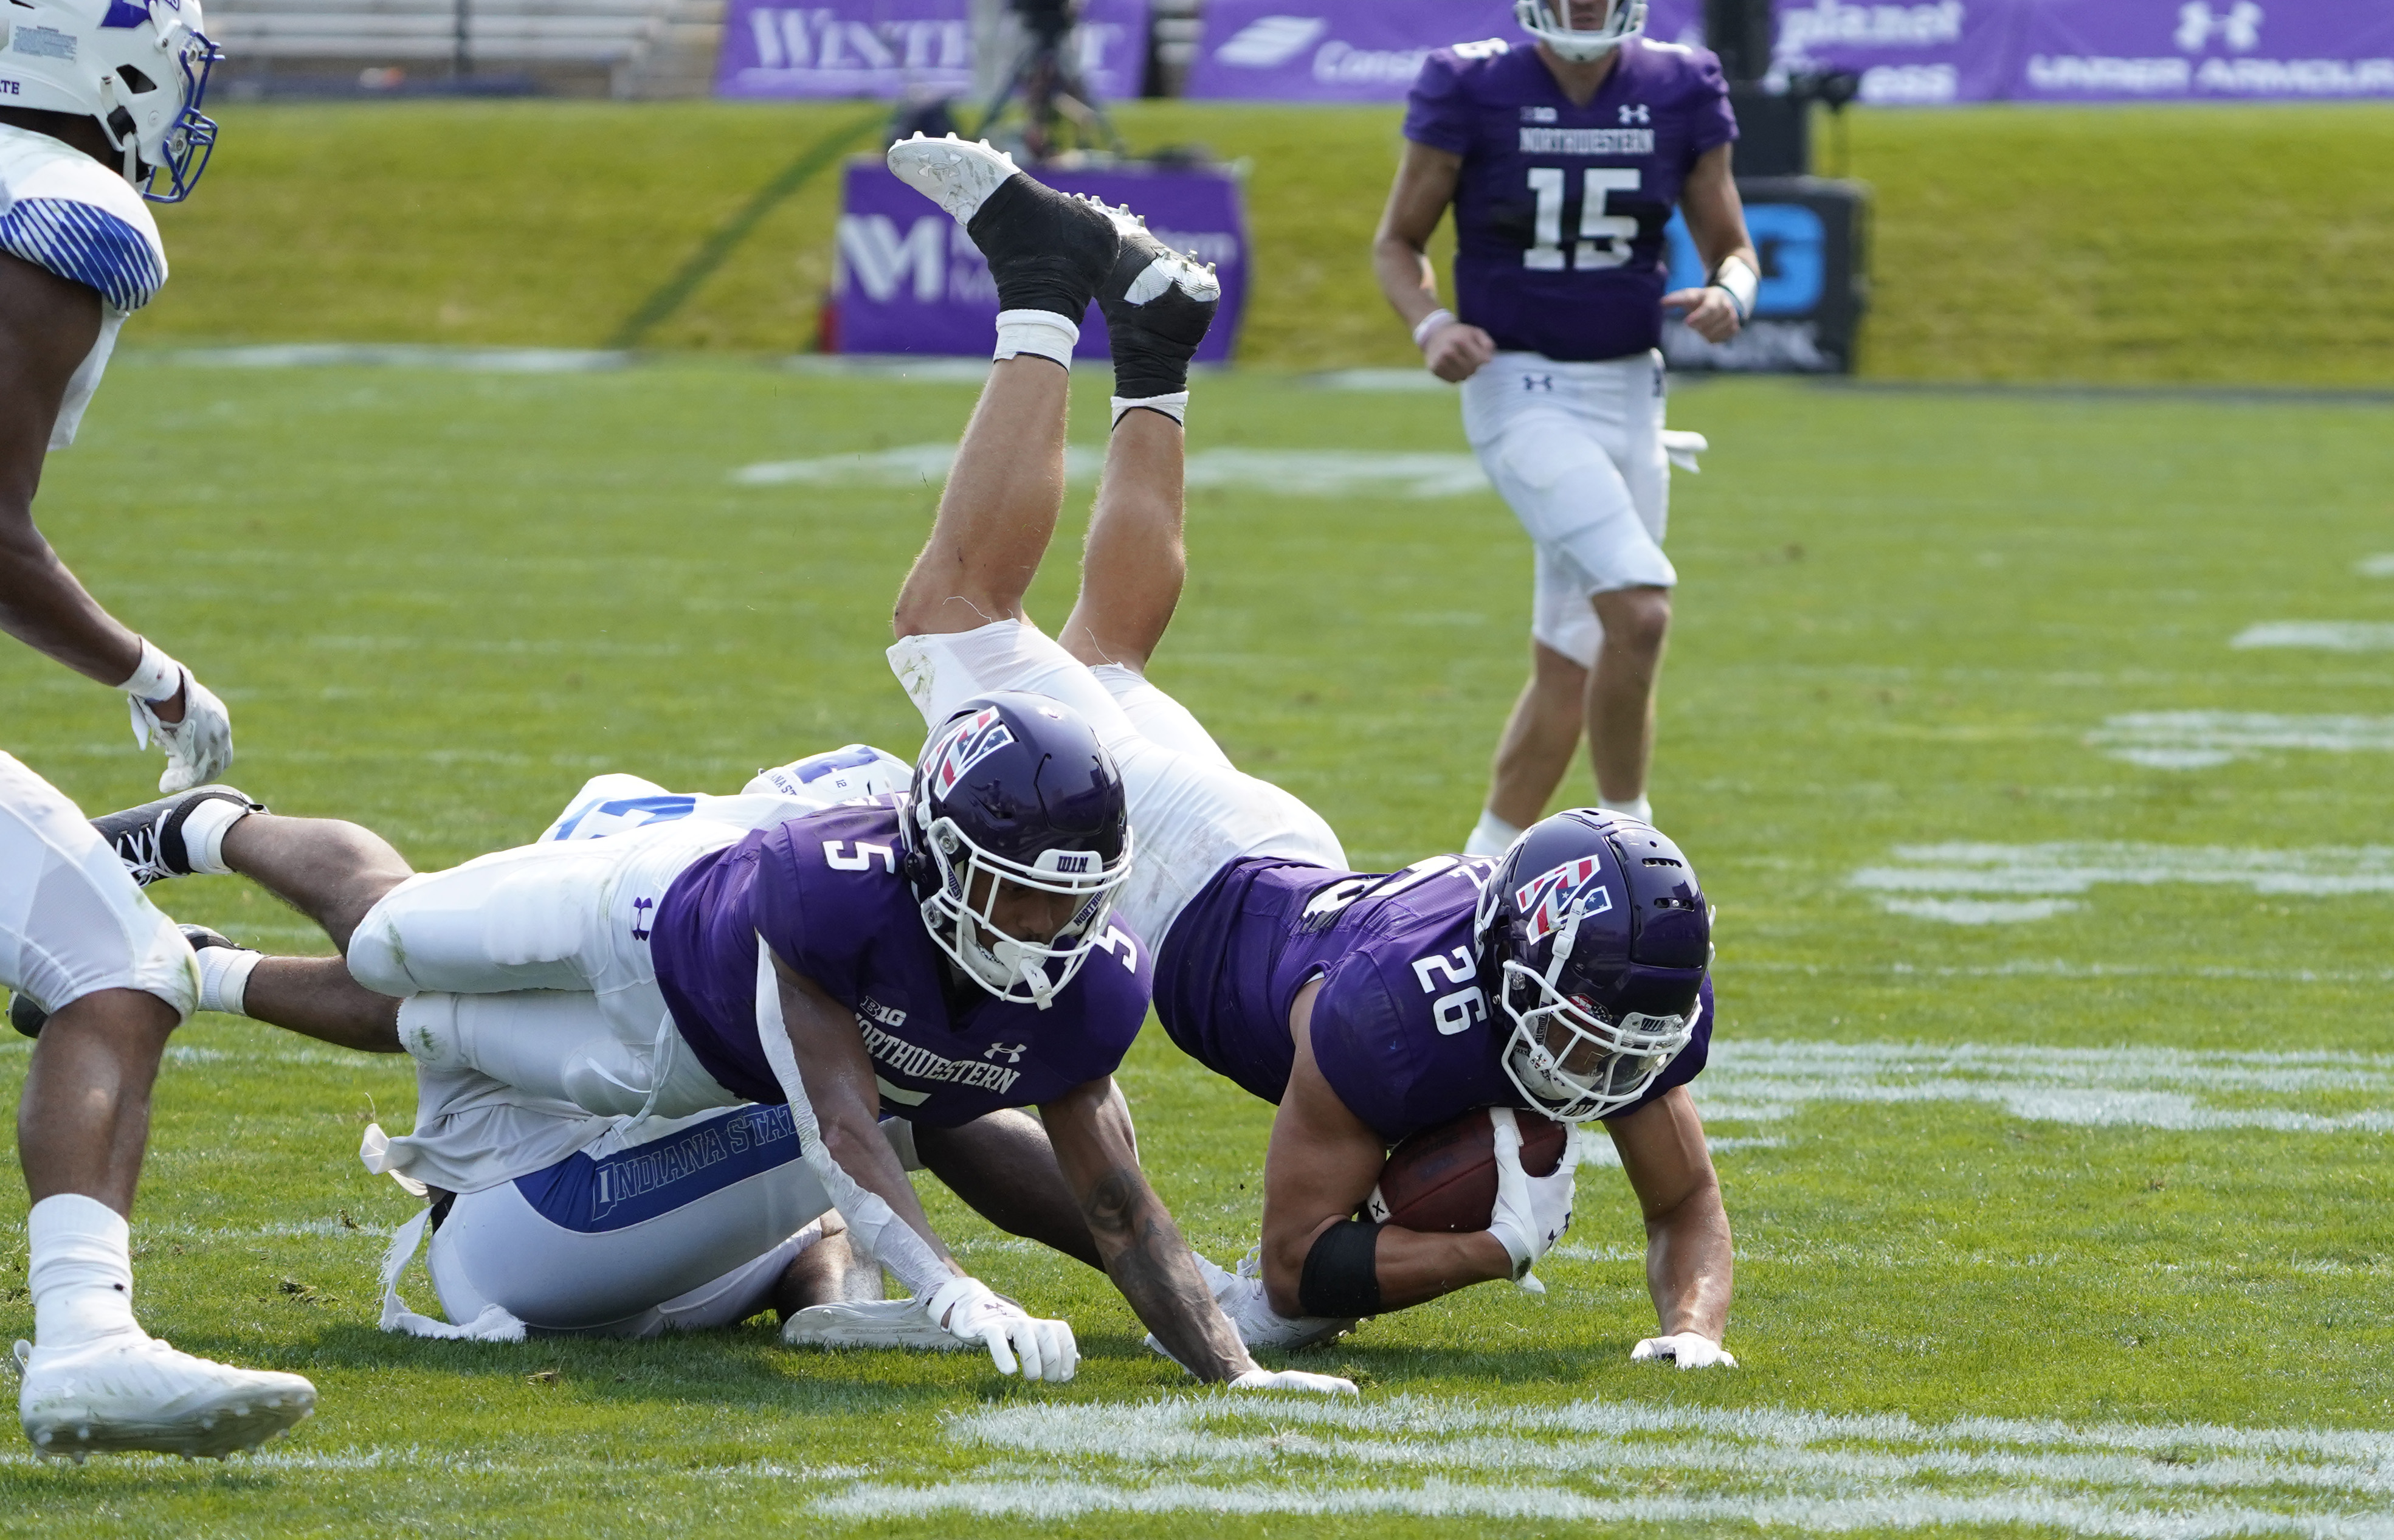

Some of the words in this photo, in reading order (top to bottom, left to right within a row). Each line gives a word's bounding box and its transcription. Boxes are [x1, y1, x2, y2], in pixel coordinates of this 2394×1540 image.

[2027, 55, 2189, 90] UNDER
[1523, 168, 1641, 271] 15
[823, 840, 895, 874] 5
[1095, 925, 1137, 974] 5
[1412, 945, 1489, 1036] 26
[855, 1012, 1021, 1094] ORTHWESTERN
[595, 1128, 728, 1205] INDIANA
[726, 1103, 799, 1154] STAT
